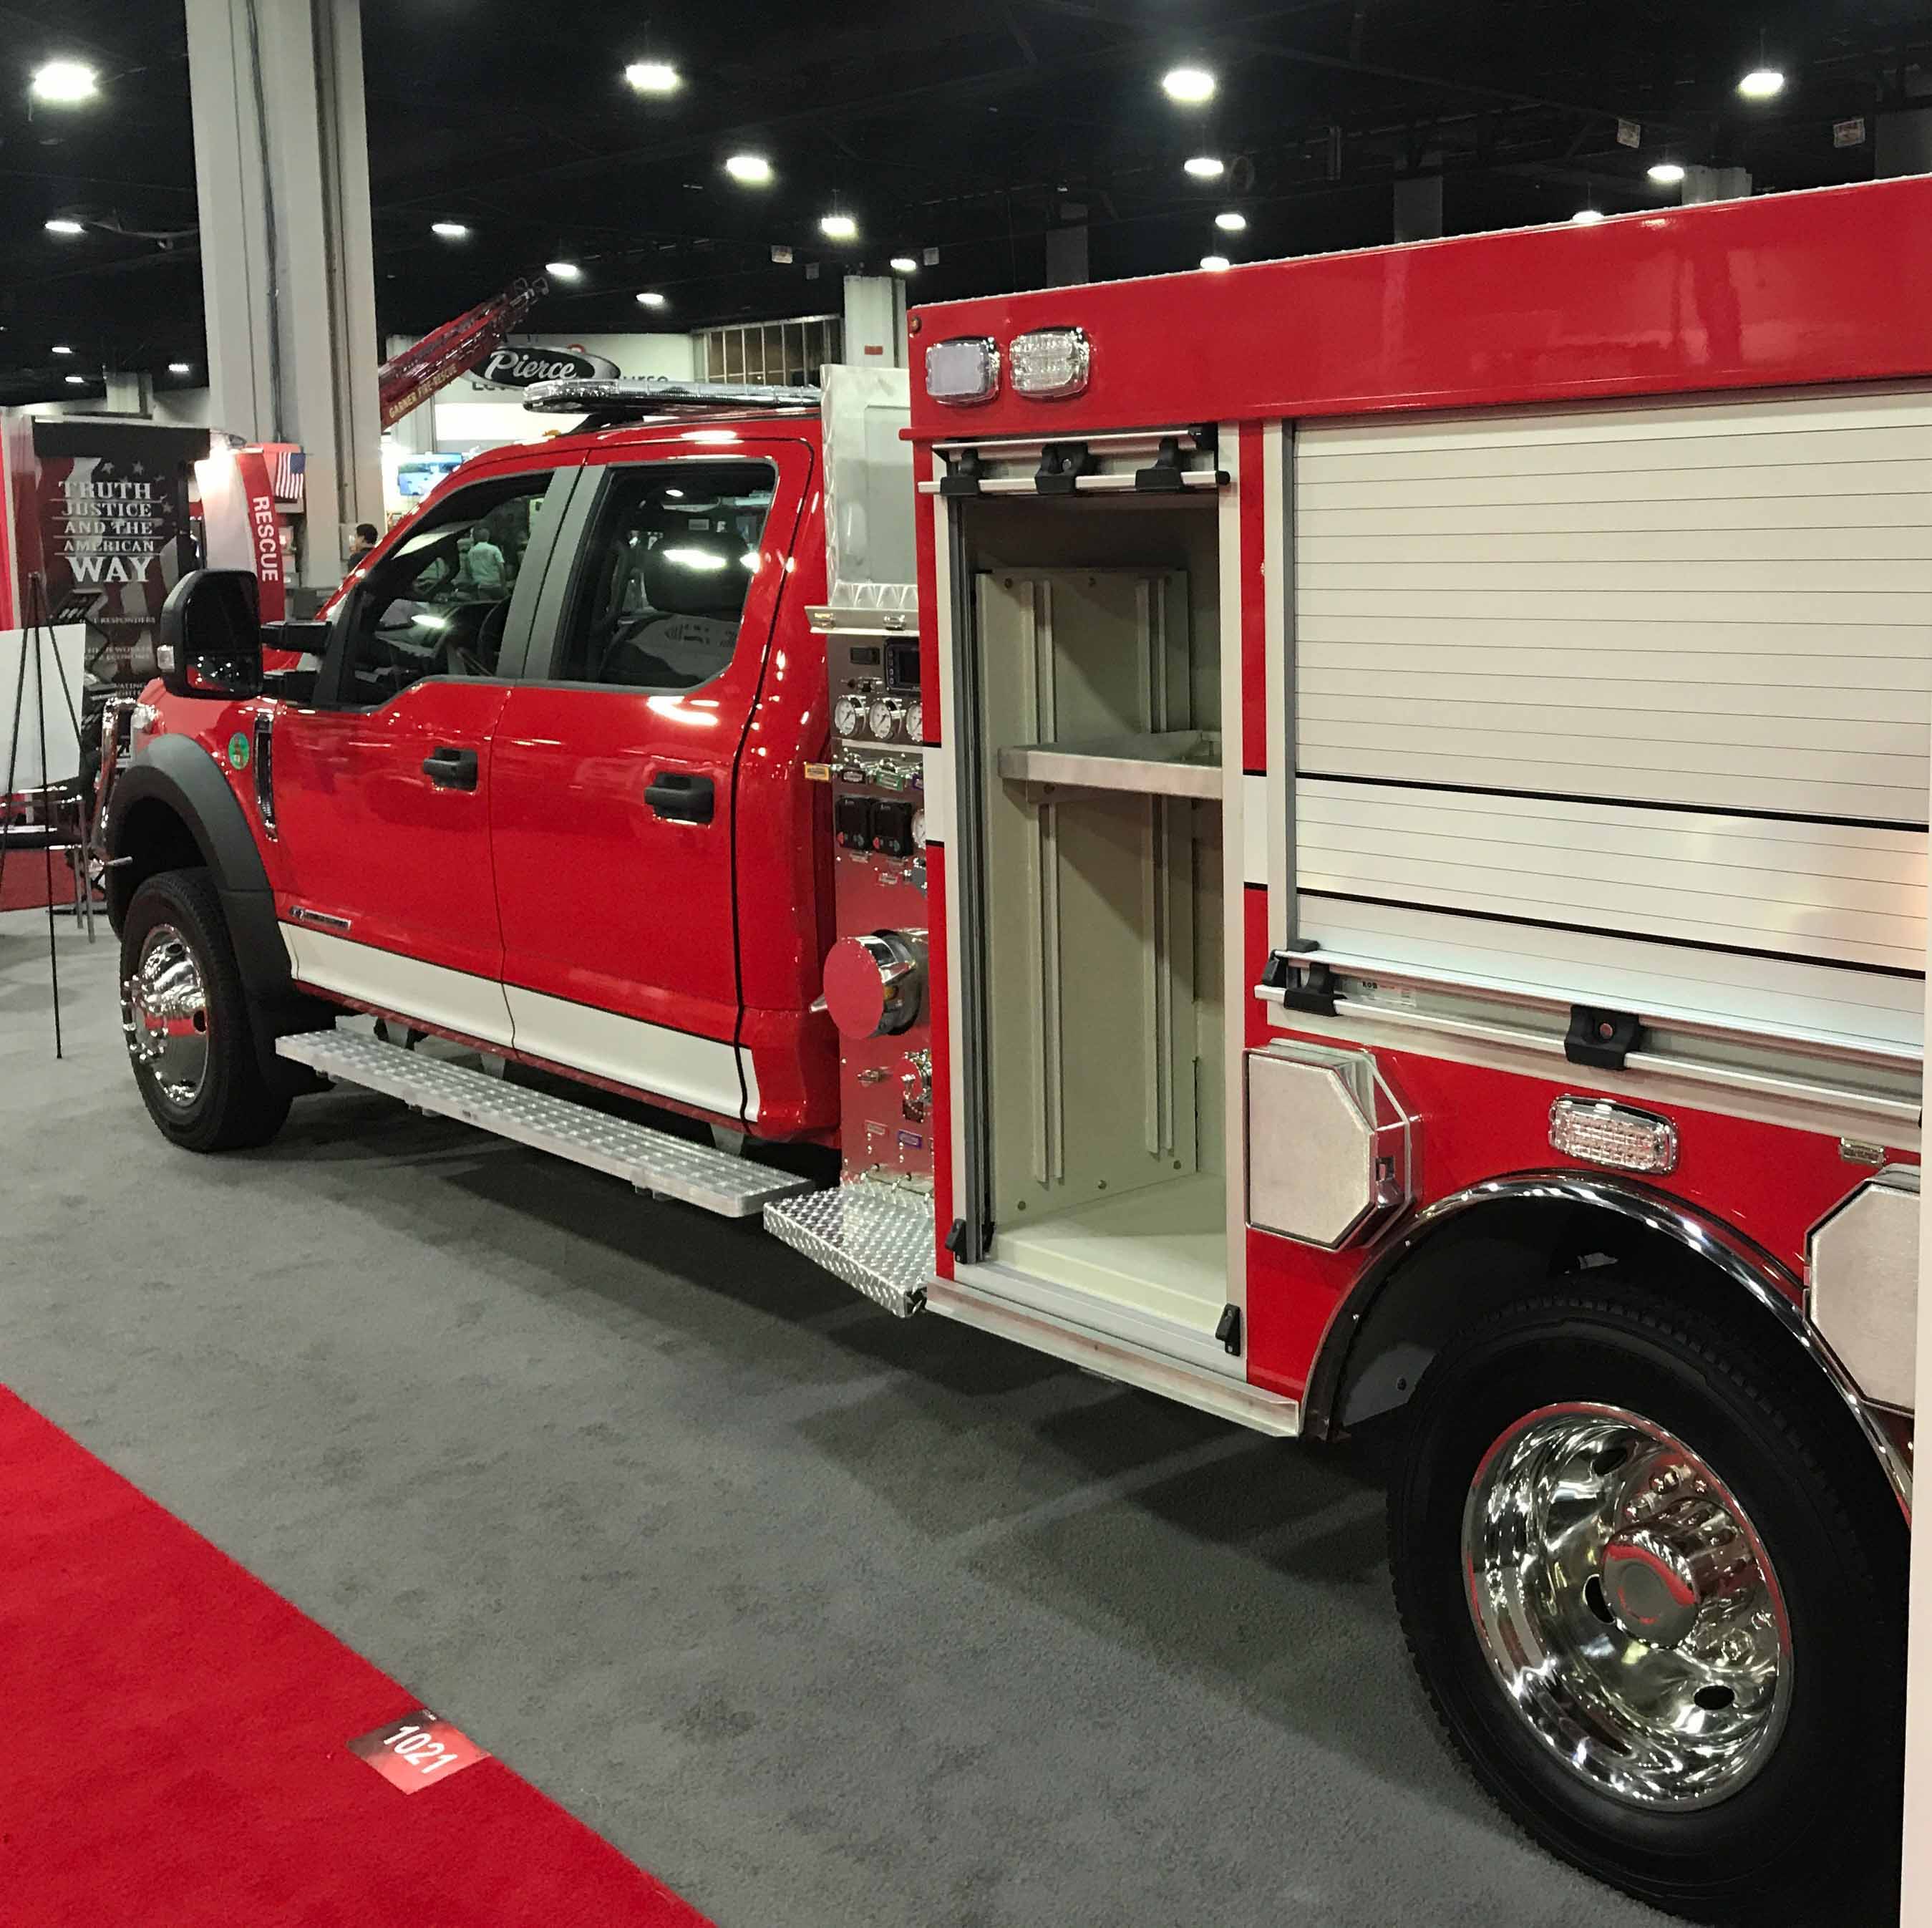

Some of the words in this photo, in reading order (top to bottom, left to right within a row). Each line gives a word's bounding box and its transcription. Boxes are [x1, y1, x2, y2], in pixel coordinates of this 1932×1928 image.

[484, 350, 578, 379] Pierce
[389, 392, 417, 419] GARNER
[58, 480, 152, 500] TRUTH
[61, 503, 152, 518] JUSTICE
[64, 520, 106, 534] AND
[111, 520, 153, 535] THE
[253, 495, 278, 582] RESCUE
[64, 540, 155, 552] AMERICAN
[64, 556, 155, 583] WAY
[383, 1725, 459, 1774] 1021
